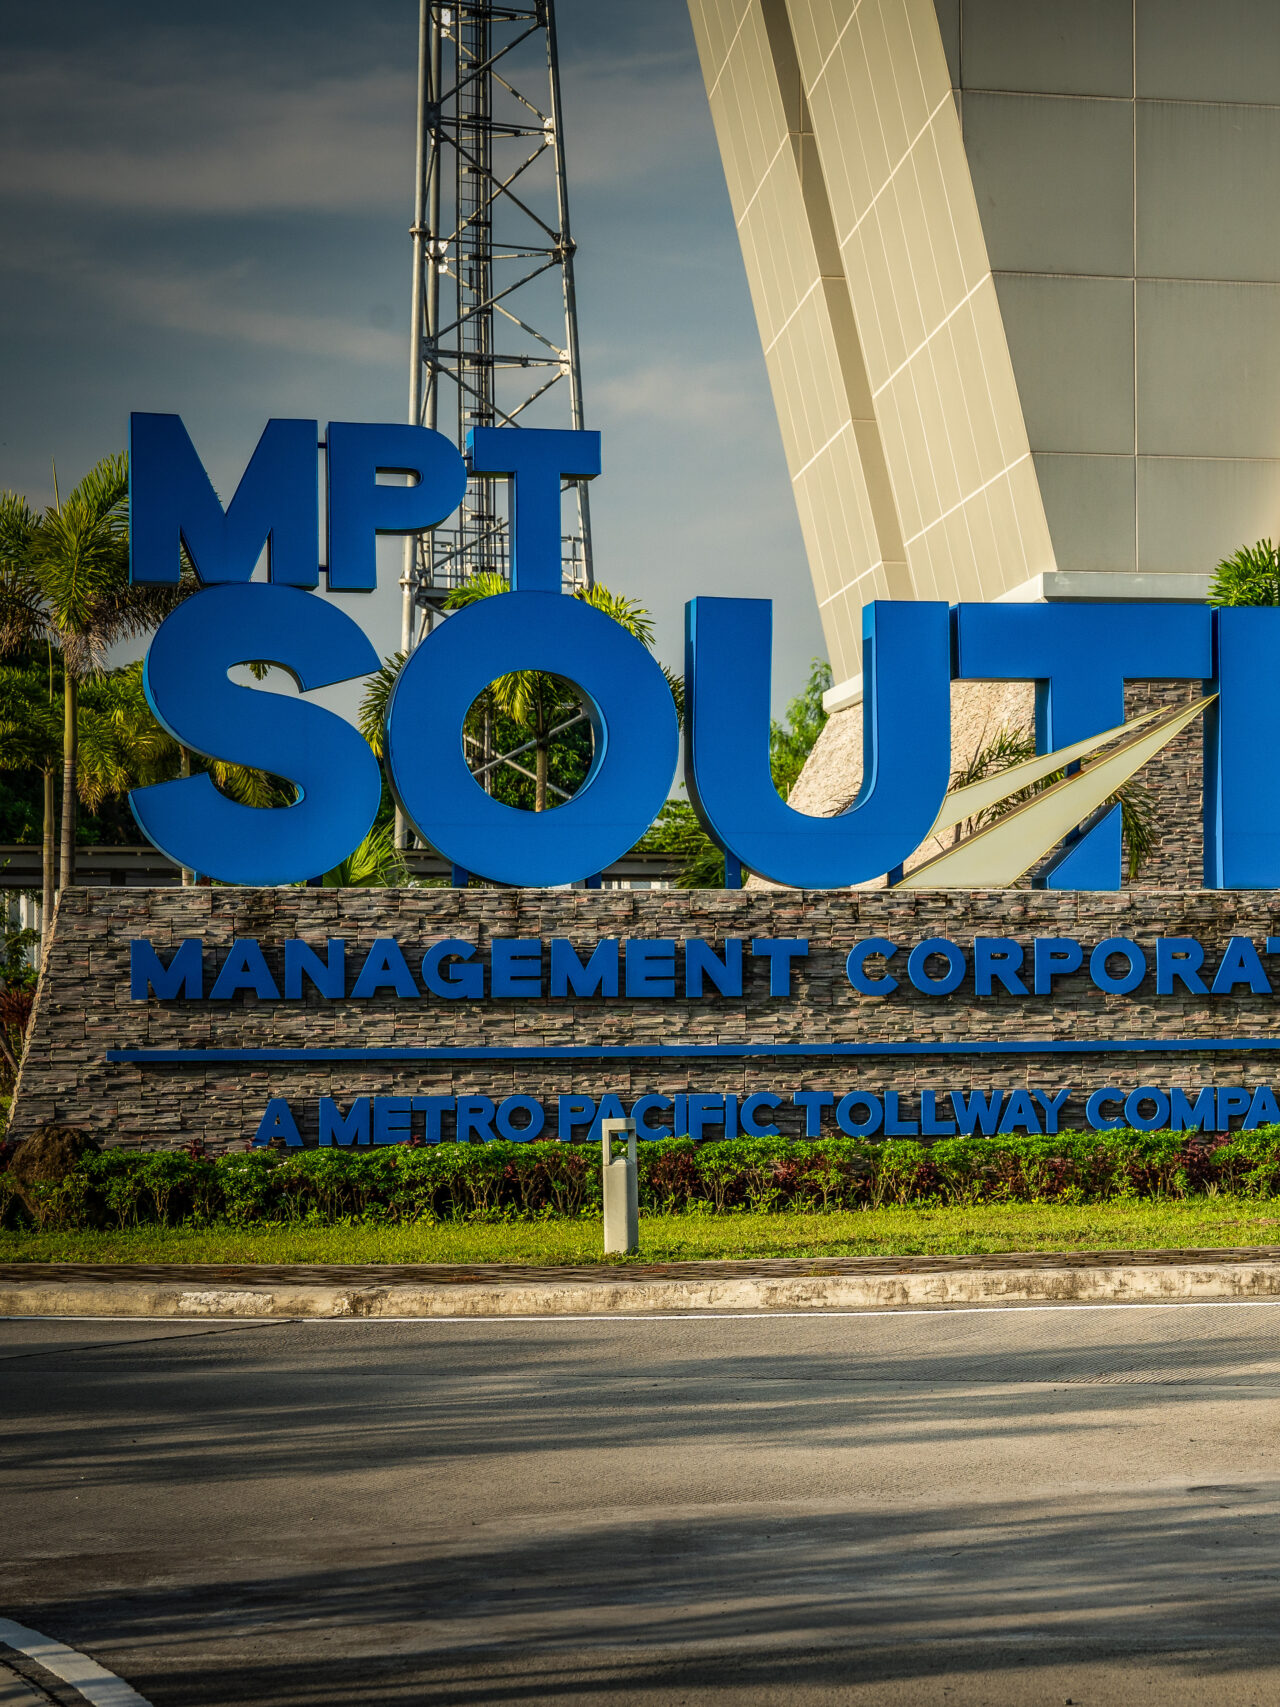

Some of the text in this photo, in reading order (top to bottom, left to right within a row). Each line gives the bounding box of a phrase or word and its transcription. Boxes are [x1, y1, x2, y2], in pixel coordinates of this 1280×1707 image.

[129, 411, 601, 592] MPT
[130, 938, 809, 1000] MANAGEMENT
[251, 1097, 304, 1147] A
[318, 1094, 545, 1146] METRO
[558, 1091, 783, 1142] PACIFIC
[793, 1088, 1073, 1138] TOLLWAY
